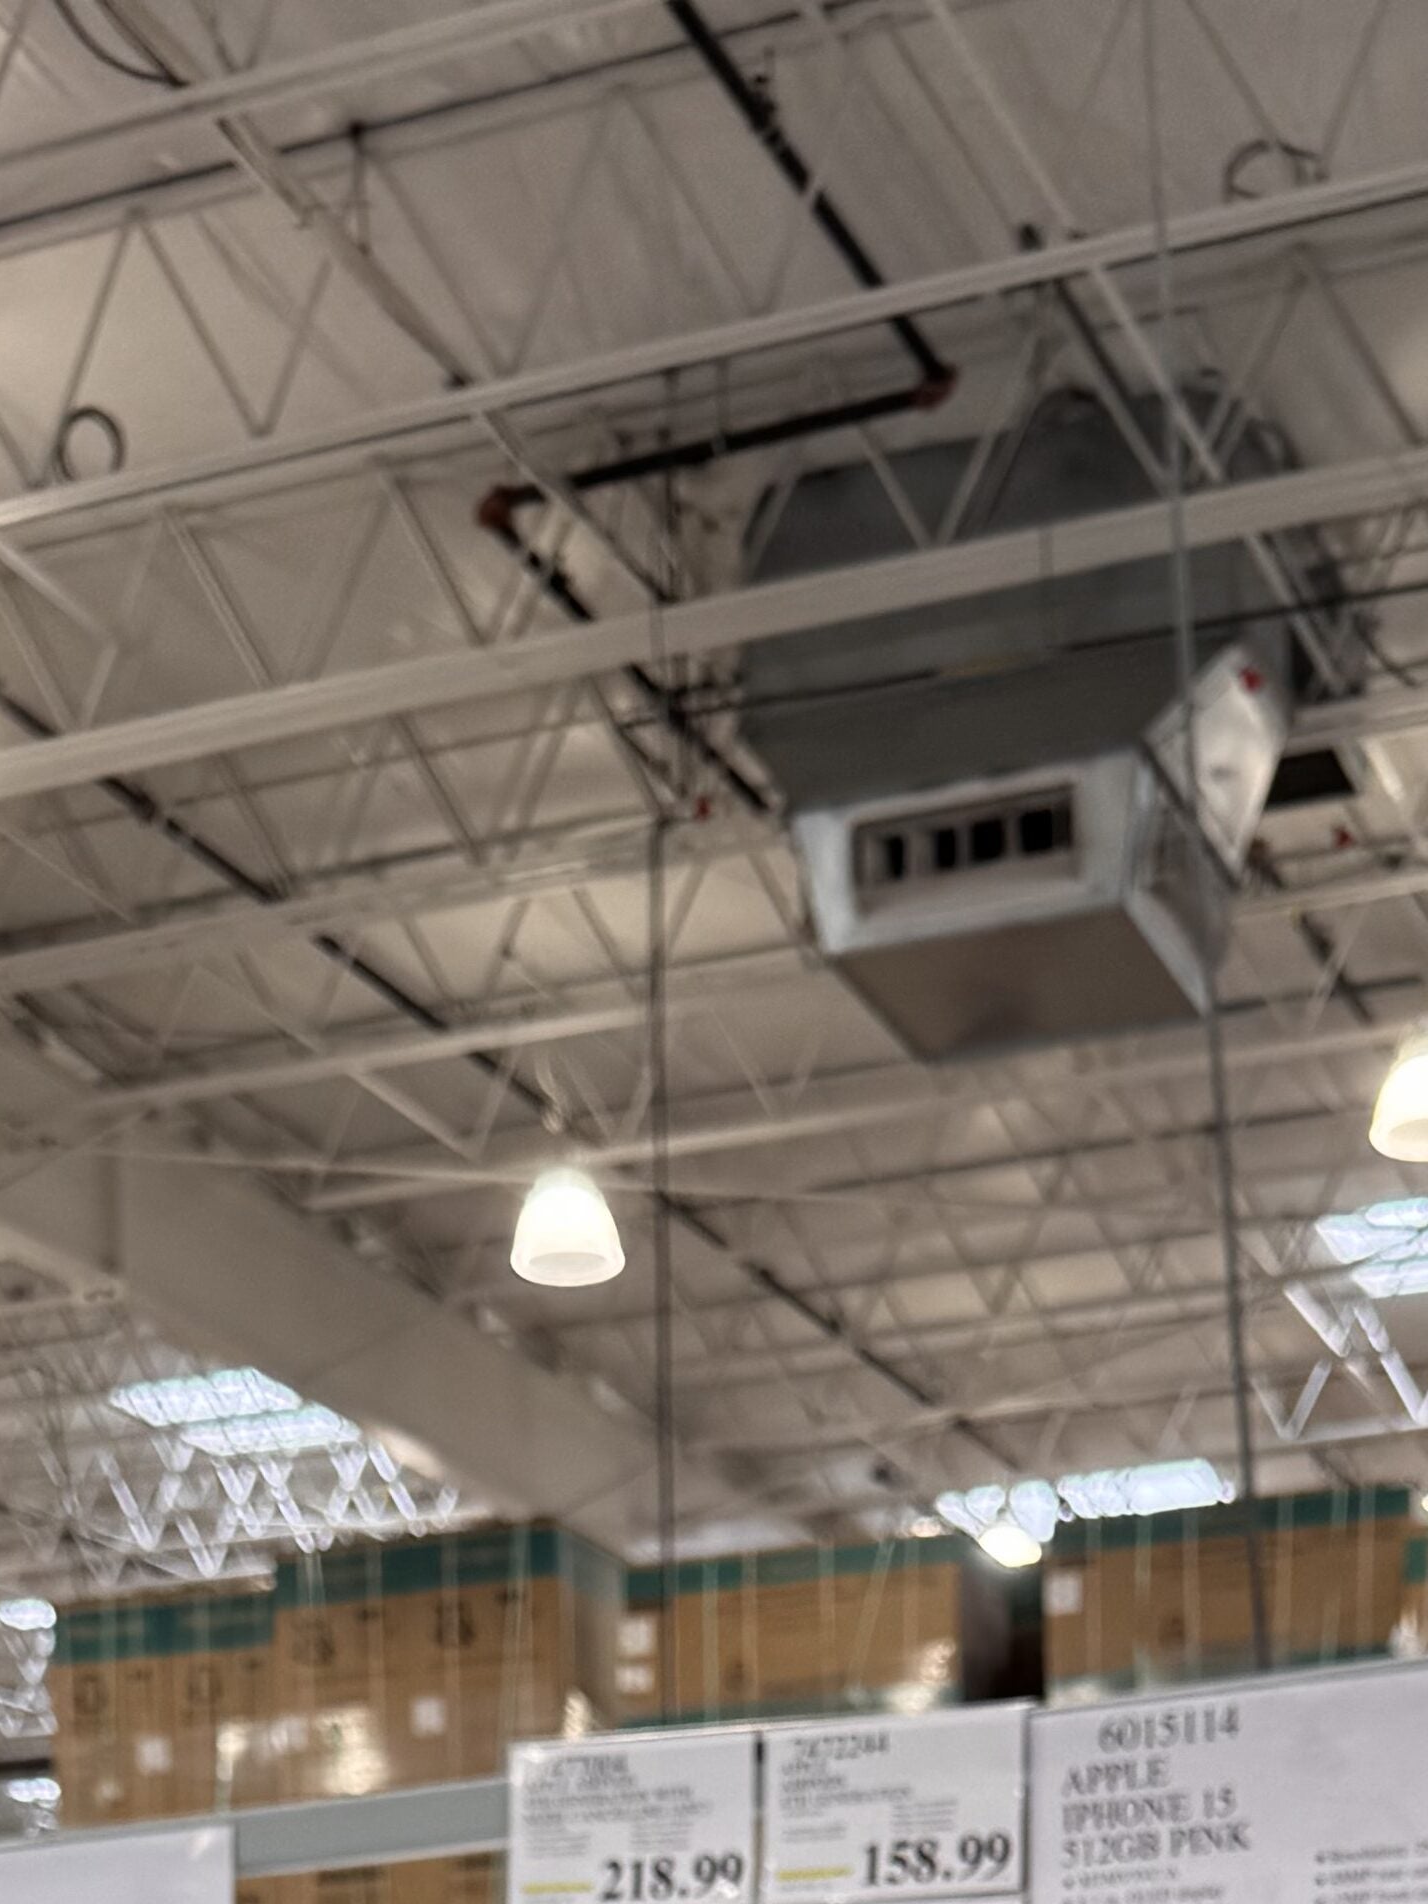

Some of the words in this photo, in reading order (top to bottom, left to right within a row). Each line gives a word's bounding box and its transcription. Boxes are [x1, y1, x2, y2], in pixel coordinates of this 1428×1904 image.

[1098, 1706, 1239, 1752] 6015114
[1062, 1758, 1168, 1795] APPLE
[1063, 1793, 1191, 1833] IPHONE
[1203, 1786, 1237, 1819] 15
[863, 1831, 1010, 1886] 158.99
[1062, 1832, 1161, 1868] 512GB
[1170, 1822, 1251, 1858] PINK
[602, 1855, 743, 1902] 218.99
